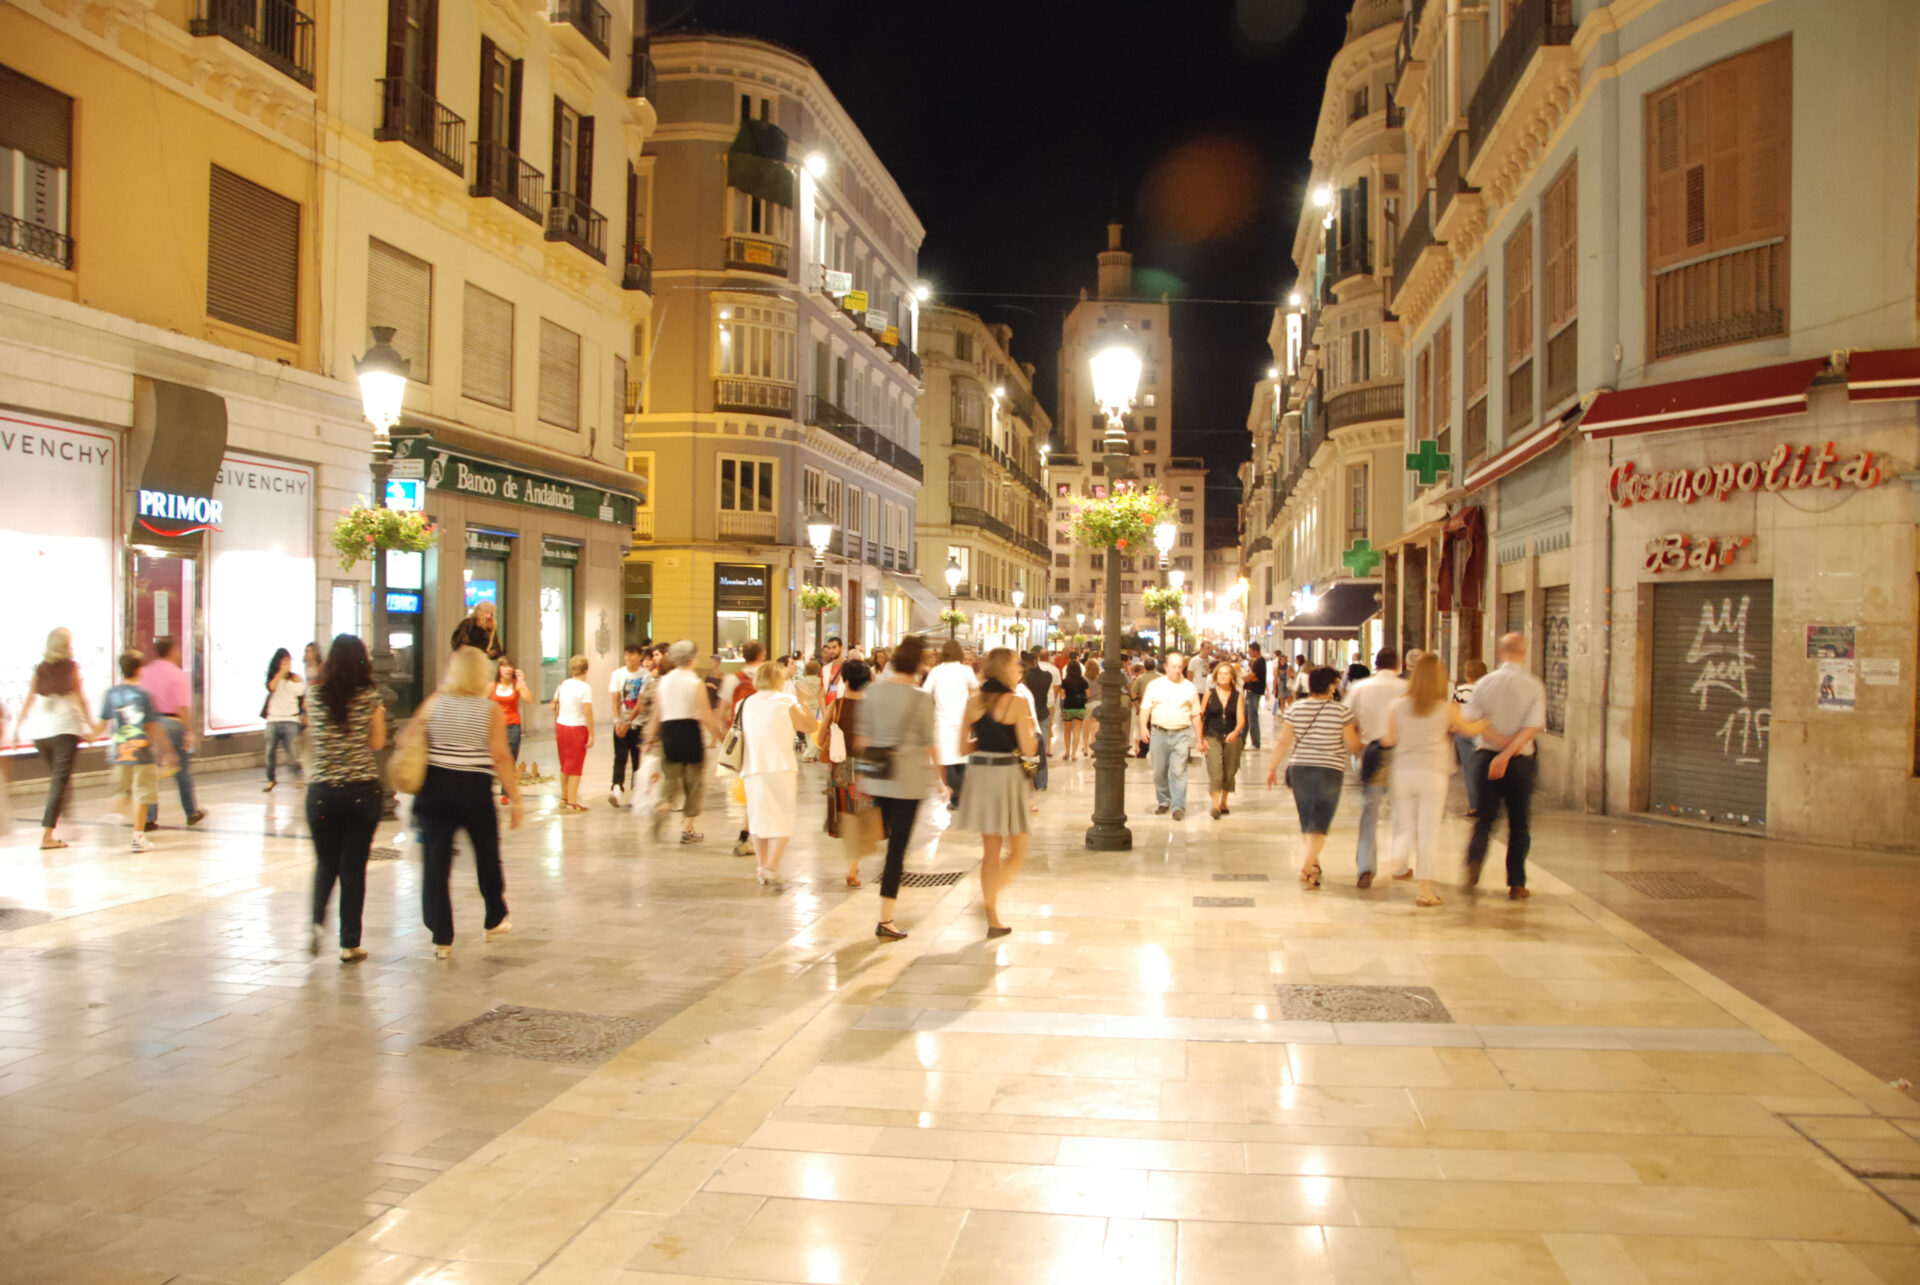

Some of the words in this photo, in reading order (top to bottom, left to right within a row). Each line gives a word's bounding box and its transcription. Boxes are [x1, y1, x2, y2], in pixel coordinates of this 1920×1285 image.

[0, 431, 109, 466] VENCHY
[215, 468, 306, 495] GIVENCHY
[457, 463, 496, 495] Banco
[502, 475, 518, 499] de
[524, 479, 575, 510] Andalucía
[1608, 441, 1881, 508] Cosmopolita
[139, 489, 224, 524] PRIMOR
[1642, 532, 1750, 573] Bar
